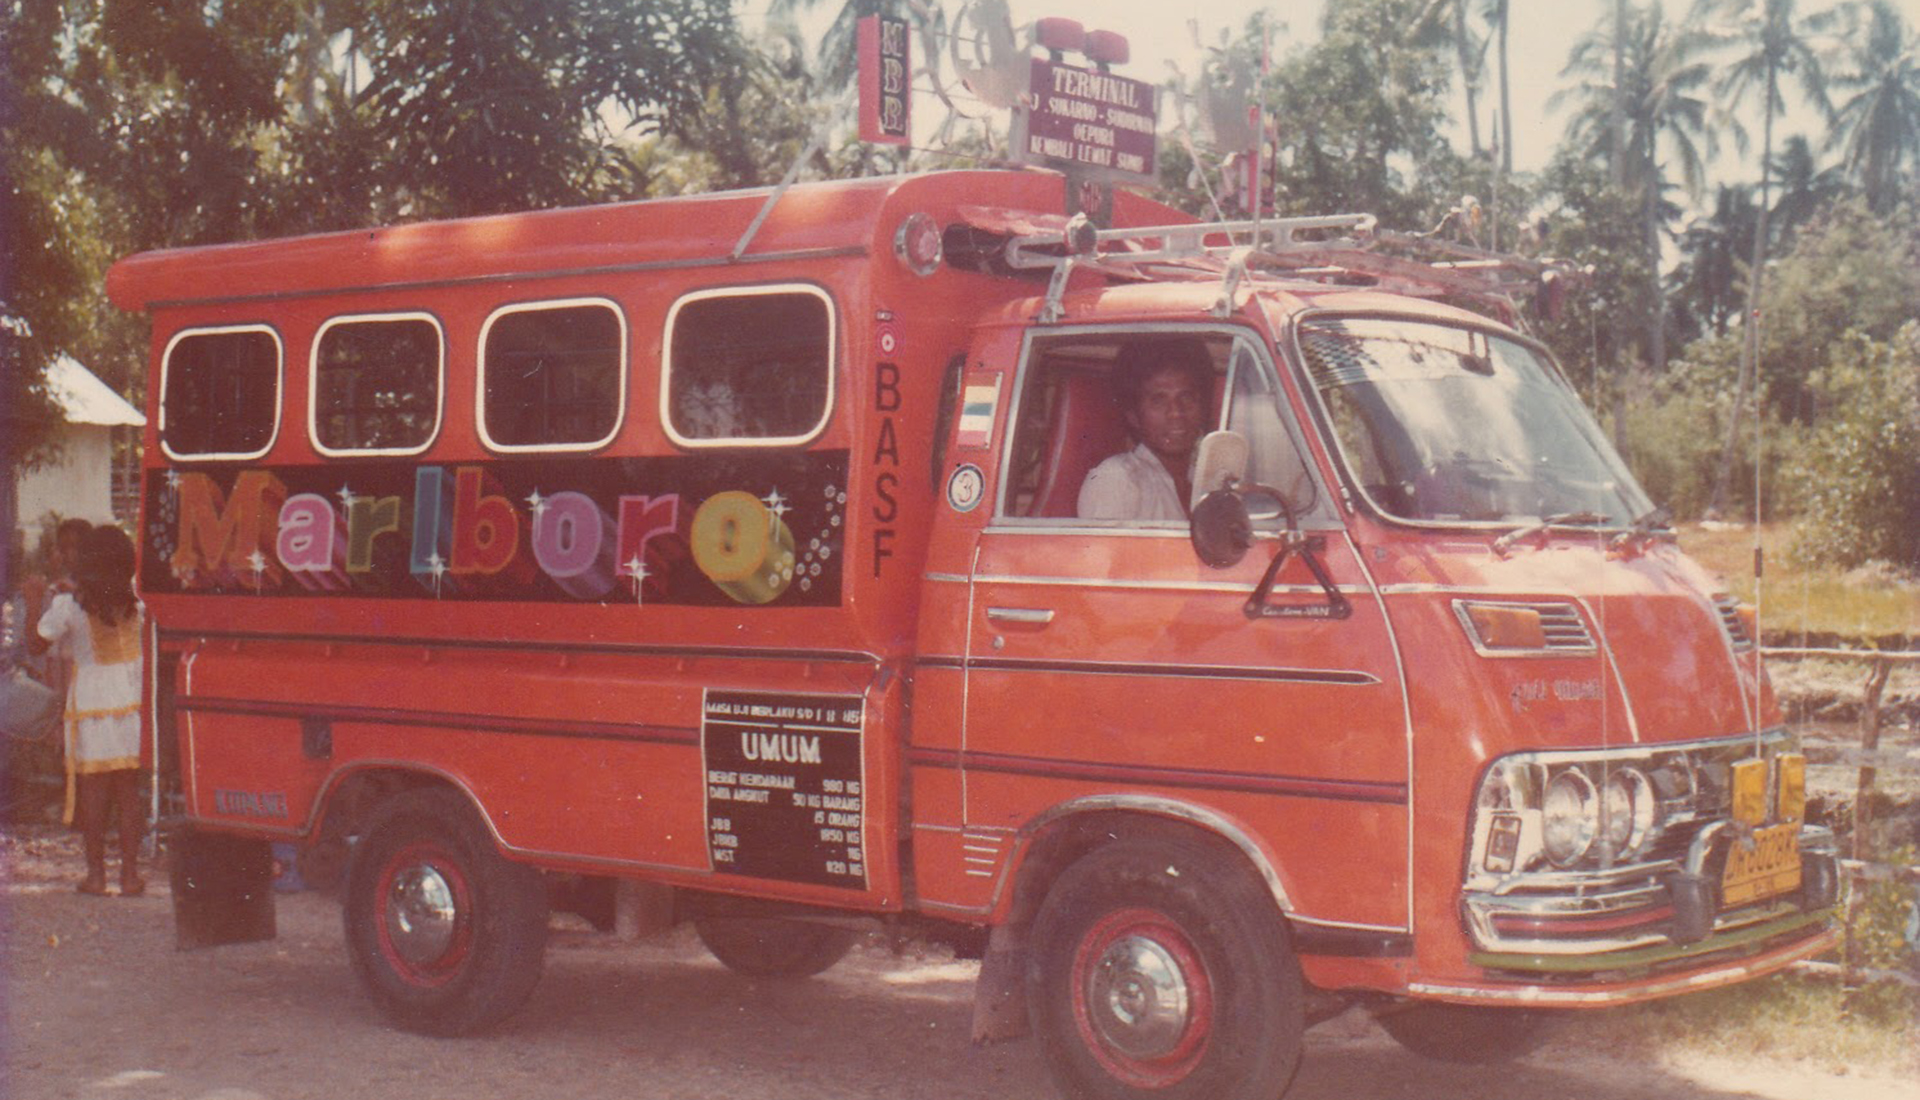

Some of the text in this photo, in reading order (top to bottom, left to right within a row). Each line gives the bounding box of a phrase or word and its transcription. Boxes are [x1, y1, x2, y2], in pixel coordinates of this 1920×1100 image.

[1052, 66, 1139, 108] TERMINAL
[873, 362, 902, 578] BASF
[173, 466, 785, 592] Marlboro
[751, 705, 796, 719] BERLAKU
[741, 732, 822, 764] UMUM
[846, 781, 860, 795] KG
[823, 795, 860, 811] BARANG
[828, 812, 860, 828] ORANG
[846, 830, 860, 845] KG
